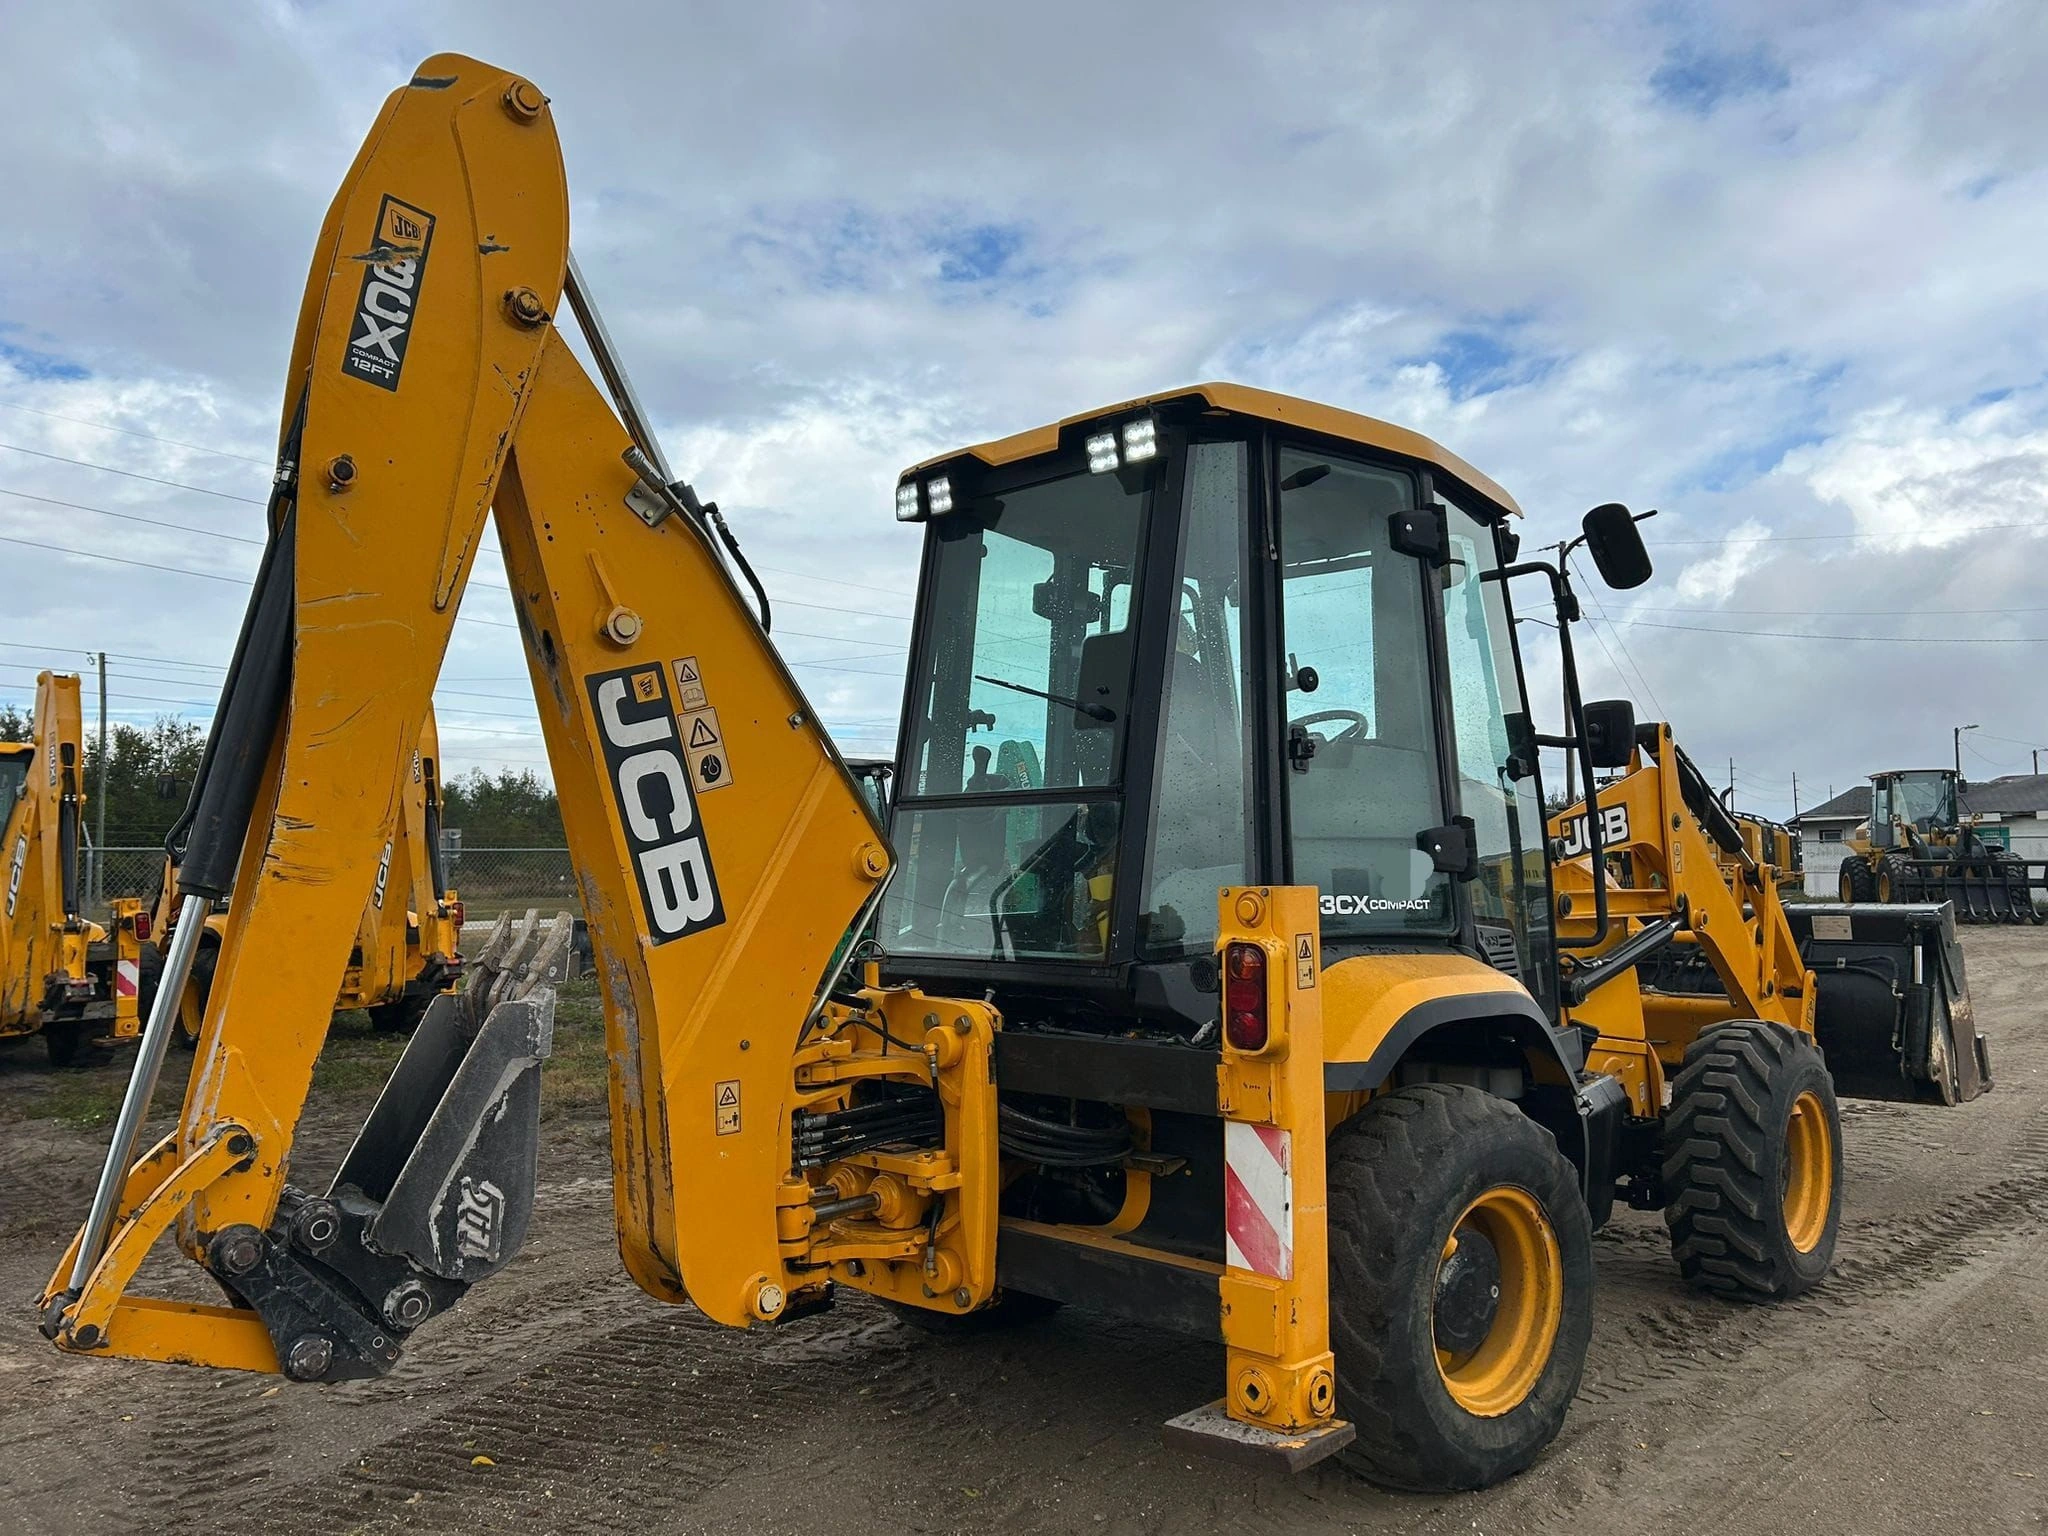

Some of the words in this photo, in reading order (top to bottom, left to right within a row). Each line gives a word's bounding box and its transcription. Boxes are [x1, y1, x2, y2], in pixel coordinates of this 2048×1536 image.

[394, 213, 420, 239] JCB
[351, 357, 394, 379] 12FT
[352, 347, 396, 368] COMPACT
[597, 677, 714, 933] JCB
[8, 838, 26, 917] JCB
[375, 842, 392, 908] JCB
[1319, 895, 1371, 915] 3CX
[1370, 899, 1431, 910] COMPACT
